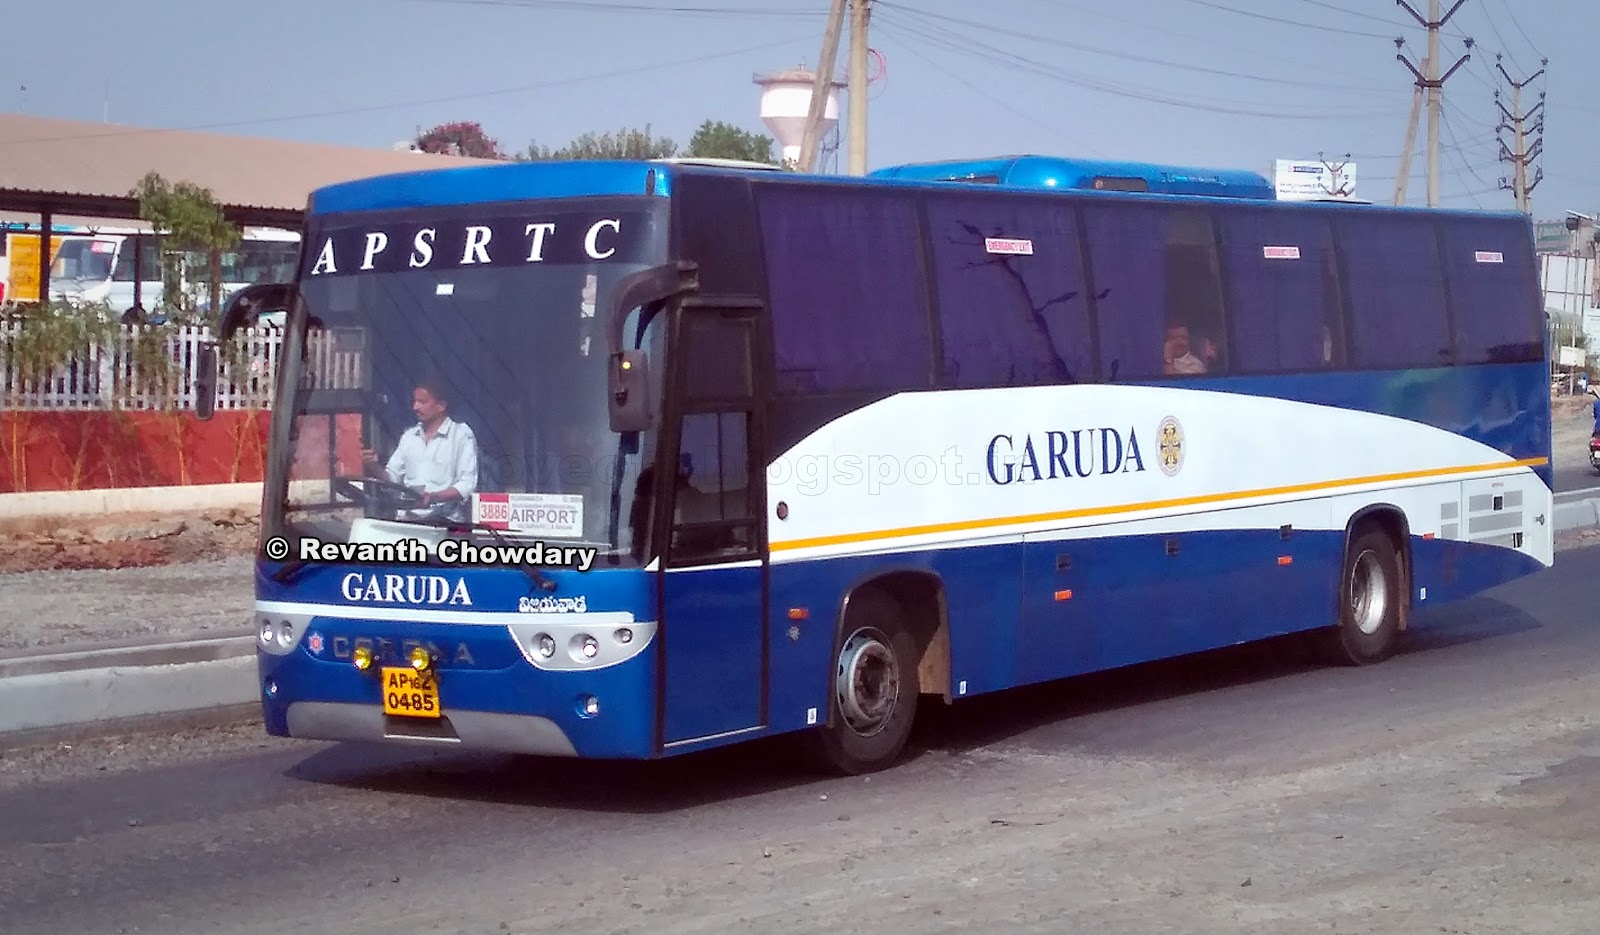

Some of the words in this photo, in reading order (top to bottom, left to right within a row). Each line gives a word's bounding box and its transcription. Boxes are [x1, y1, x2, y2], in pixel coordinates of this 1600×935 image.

[986, 425, 1146, 485] GARUDA
[481, 504, 508, 519] 3886
[510, 508, 579, 524] AIRPORT
[341, 572, 473, 606] GARUDA
[388, 692, 435, 711] 0485
